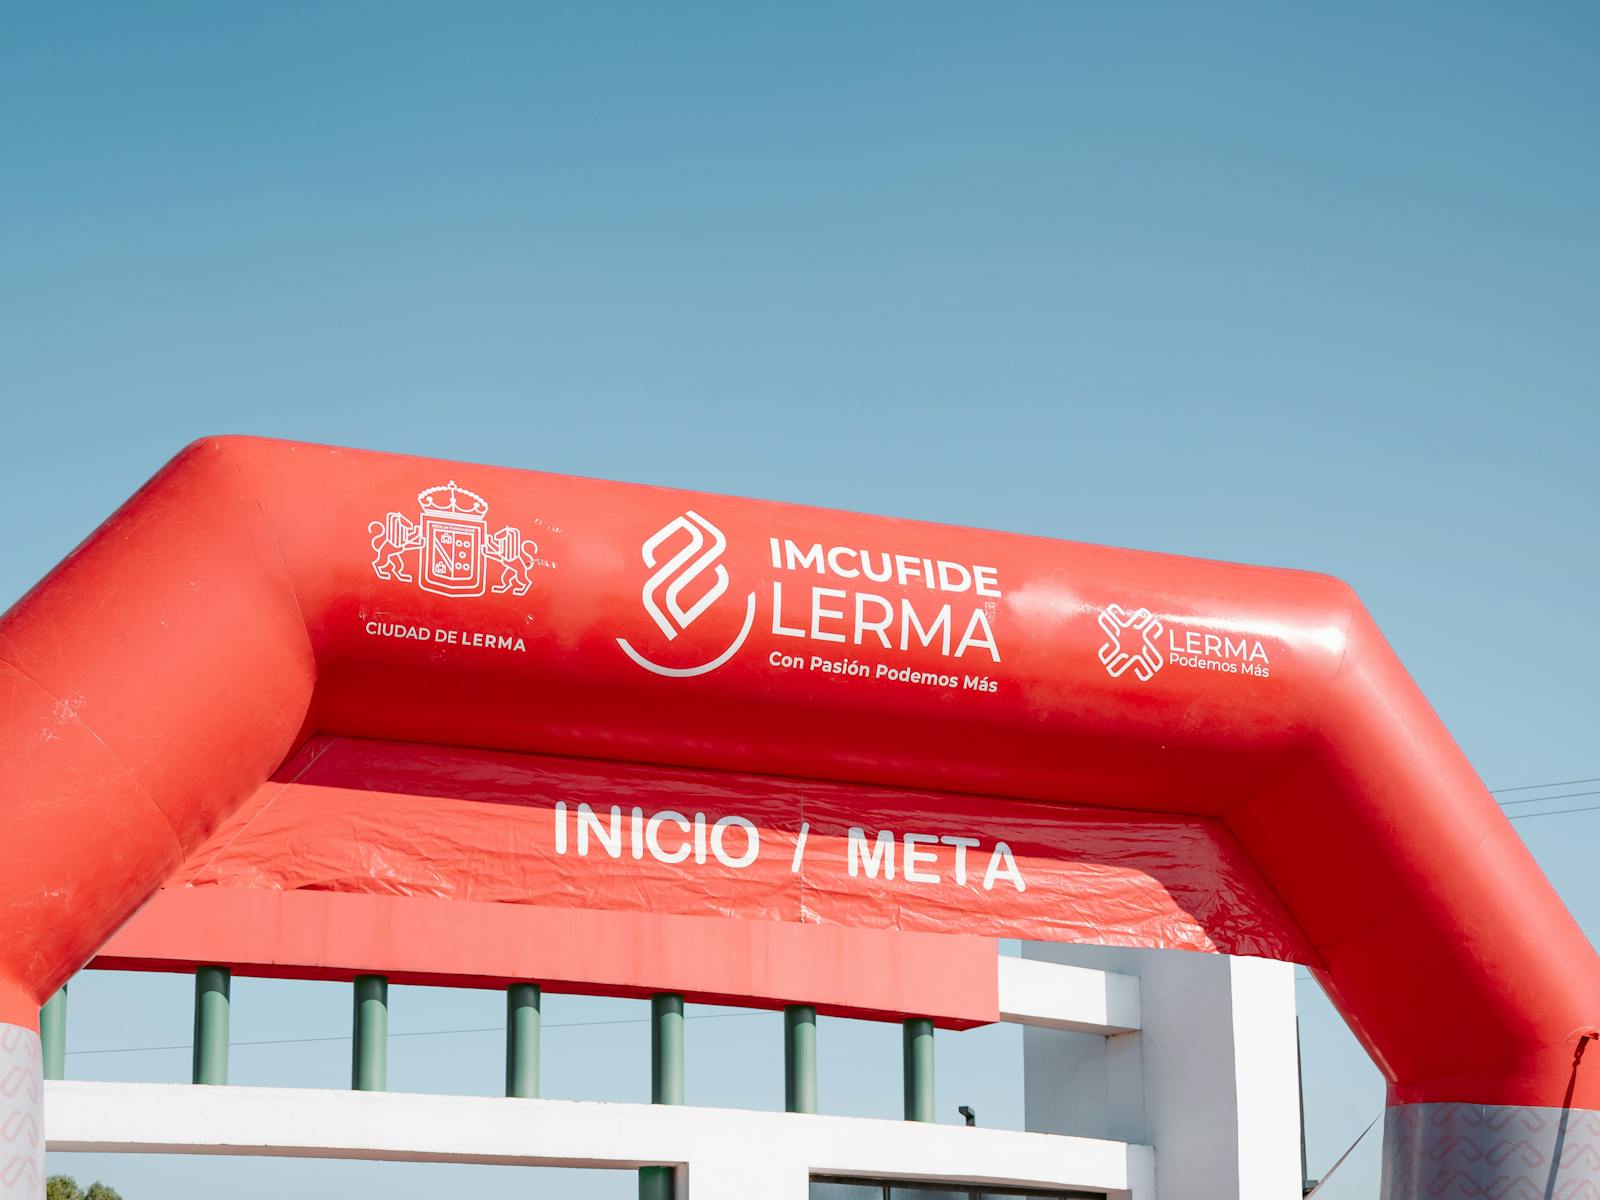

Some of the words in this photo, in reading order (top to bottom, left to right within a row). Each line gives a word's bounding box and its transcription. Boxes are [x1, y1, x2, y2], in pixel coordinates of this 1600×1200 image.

[769, 537, 1002, 598] IMCUFIDE
[365, 621, 431, 641] CIUDAD
[434, 629, 458, 644] DE
[461, 631, 527, 653] LERMA
[771, 581, 1002, 663] LERMA
[1169, 629, 1270, 664] LERMA
[1169, 653, 1238, 674] Podemos
[1241, 662, 1270, 678] Más
[768, 650, 805, 669] Con
[809, 656, 870, 678] Pasión
[875, 664, 959, 688] Podemos
[962, 674, 999, 693] Más
[555, 800, 761, 869] INICIO
[790, 822, 810, 874] /
[846, 826, 1027, 893] META
